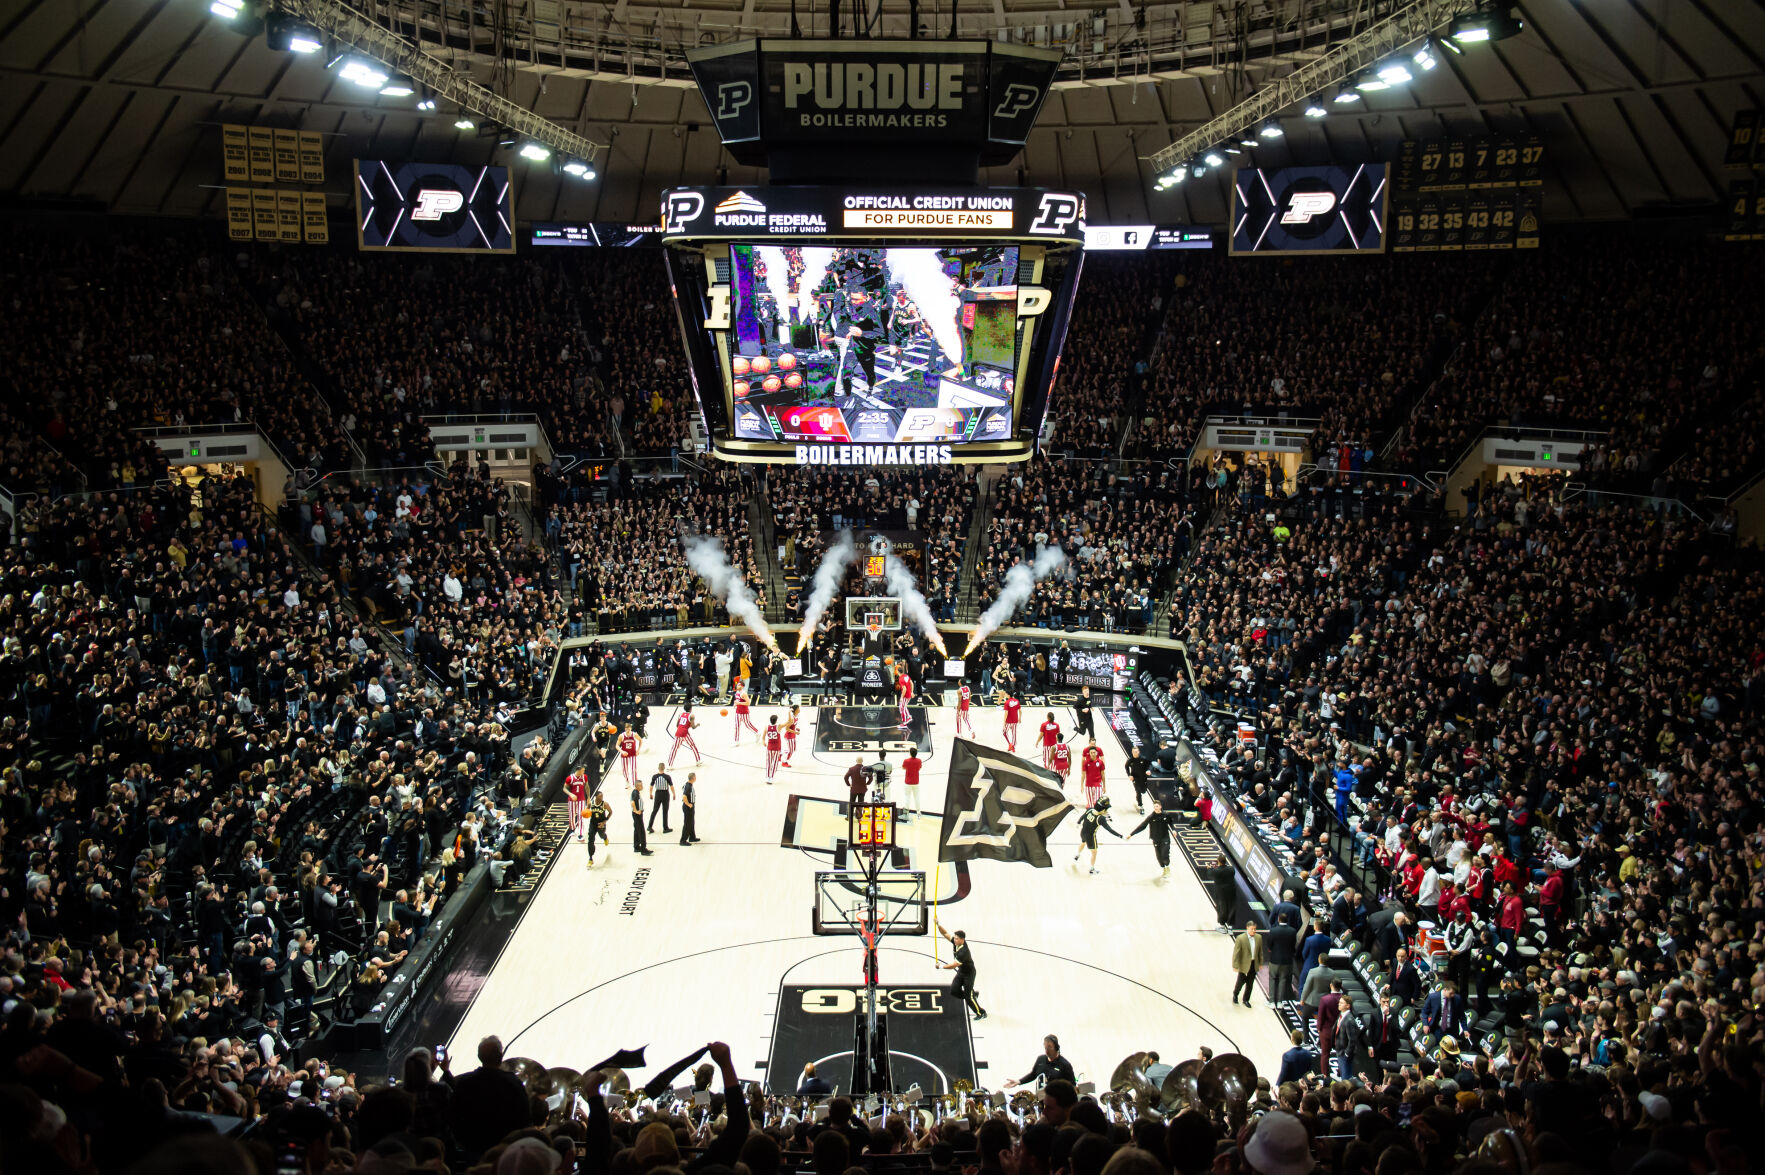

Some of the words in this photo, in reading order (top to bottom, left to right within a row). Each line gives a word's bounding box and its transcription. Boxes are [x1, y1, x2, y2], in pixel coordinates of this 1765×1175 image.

[784, 62, 963, 110] PURDUE
[800, 113, 947, 128] BOILERMAKERS
[1733, 127, 1752, 144] 10
[1421, 152, 1442, 171] 27
[1448, 152, 1464, 169] 13
[1476, 150, 1488, 167] 7
[1496, 148, 1518, 166] 23
[1521, 146, 1544, 165] 37
[844, 196, 910, 209] OFFICIAL
[914, 196, 964, 209] CREDIT
[968, 197, 1013, 210] UNION
[715, 214, 766, 227] PURDUE
[769, 214, 826, 226] FEDERAL
[865, 213, 893, 224] FOR
[898, 213, 953, 225] PURDUE
[959, 213, 993, 225] FANS
[1398, 215, 1414, 231] 19
[1418, 213, 1440, 231] 32
[1443, 212, 1464, 229] 35
[1467, 211, 1489, 228] 43
[1492, 210, 1514, 228] 42
[791, 415, 800, 427] 0
[858, 412, 888, 423] 2:35
[796, 445, 952, 465] BOILERMAKERS
[867, 563, 882, 576] 30
[1129, 658, 1136, 667] 0
[1084, 675, 1111, 687] HOUSE
[962, 692, 970, 700] 53
[767, 731, 778, 739] 32
[1057, 750, 1068, 758] 22
[630, 867, 652, 890] KEADY
[619, 890, 644, 916] COURT
